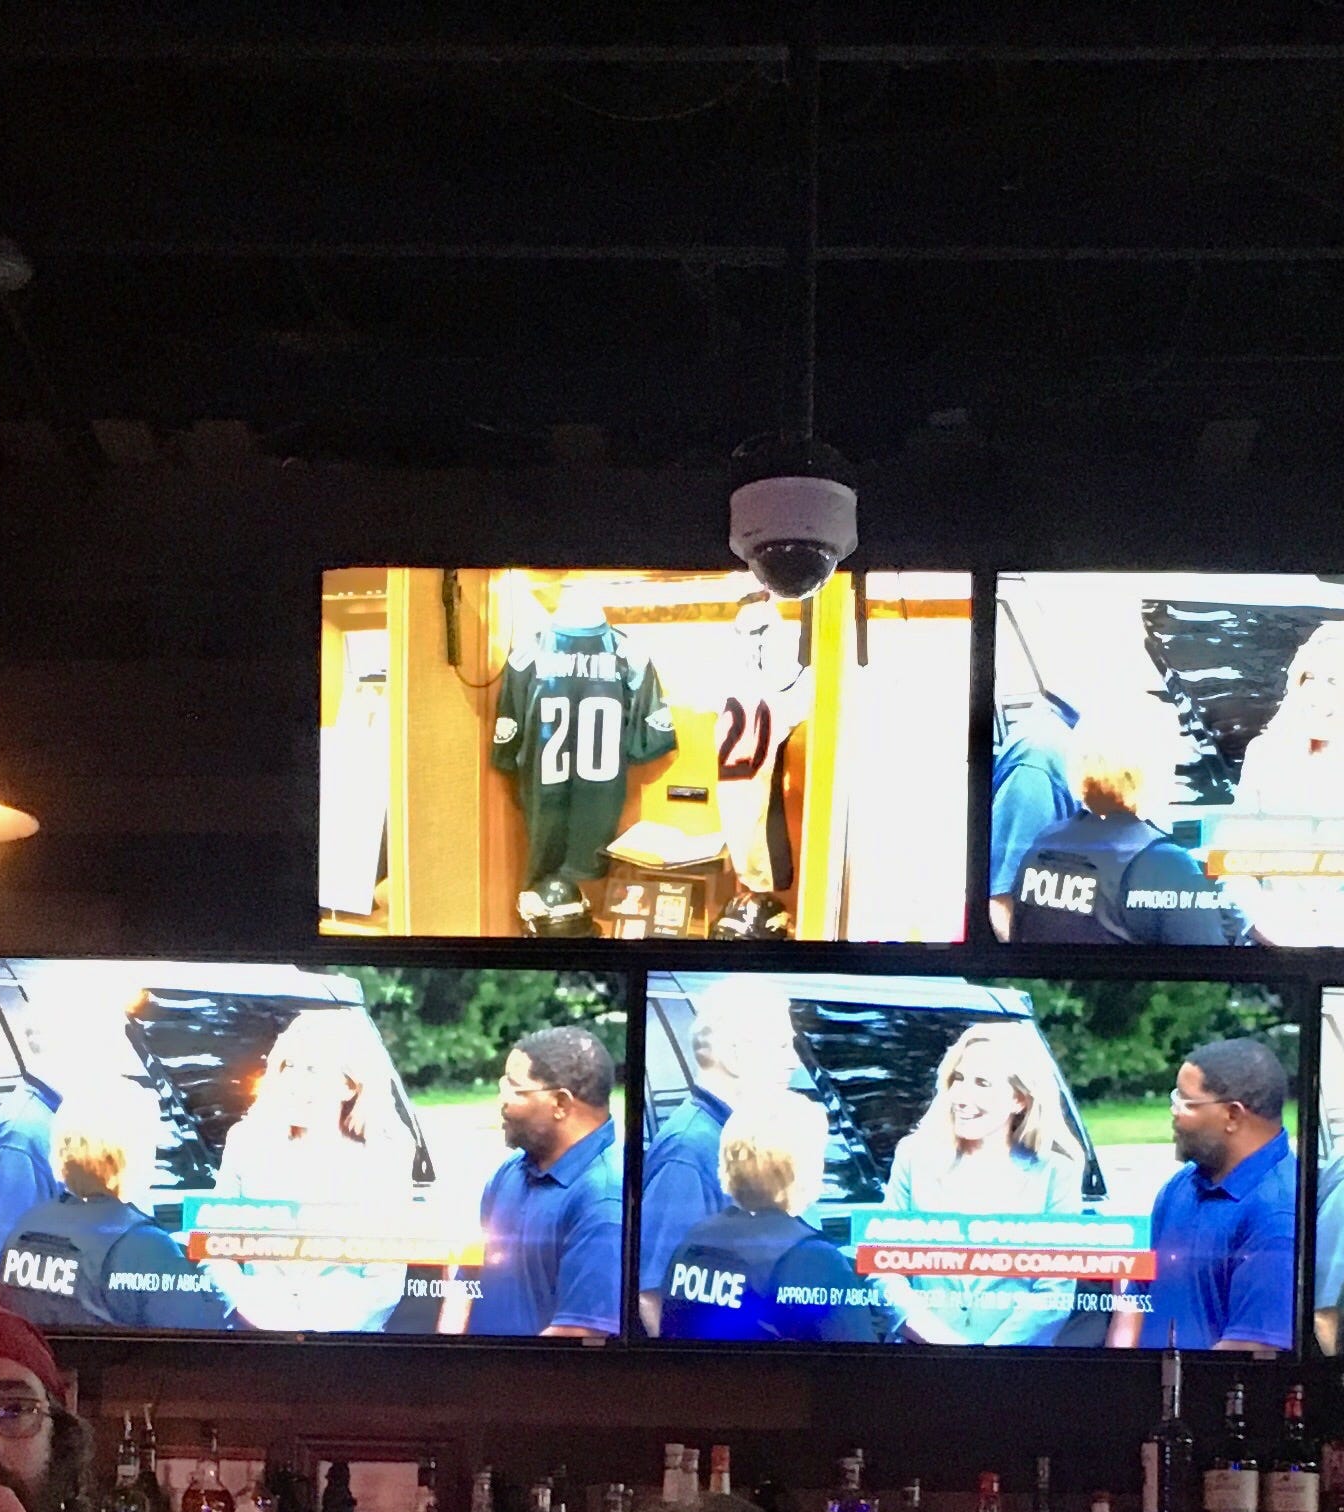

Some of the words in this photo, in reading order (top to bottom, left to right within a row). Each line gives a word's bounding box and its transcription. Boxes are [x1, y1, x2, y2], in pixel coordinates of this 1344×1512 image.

[540, 696, 623, 785] 20
[1020, 867, 1097, 914] POLICE
[3, 1248, 79, 1295] POLICE
[109, 1272, 160, 1292] APPROVED
[161, 1273, 176, 1292] BY
[407, 1279, 428, 1297] FOR
[429, 1279, 484, 1299] COESS.
[873, 1250, 968, 1272] COUNTRY
[969, 1252, 1013, 1273] AND
[1014, 1253, 1136, 1275] COMMUNITY
[670, 1263, 746, 1309] POLICE
[776, 1286, 827, 1307] APPROVED
[829, 1287, 843, 1307] BY
[845, 1287, 882, 1308] ABIGAIL
[1077, 1292, 1098, 1312] FOR
